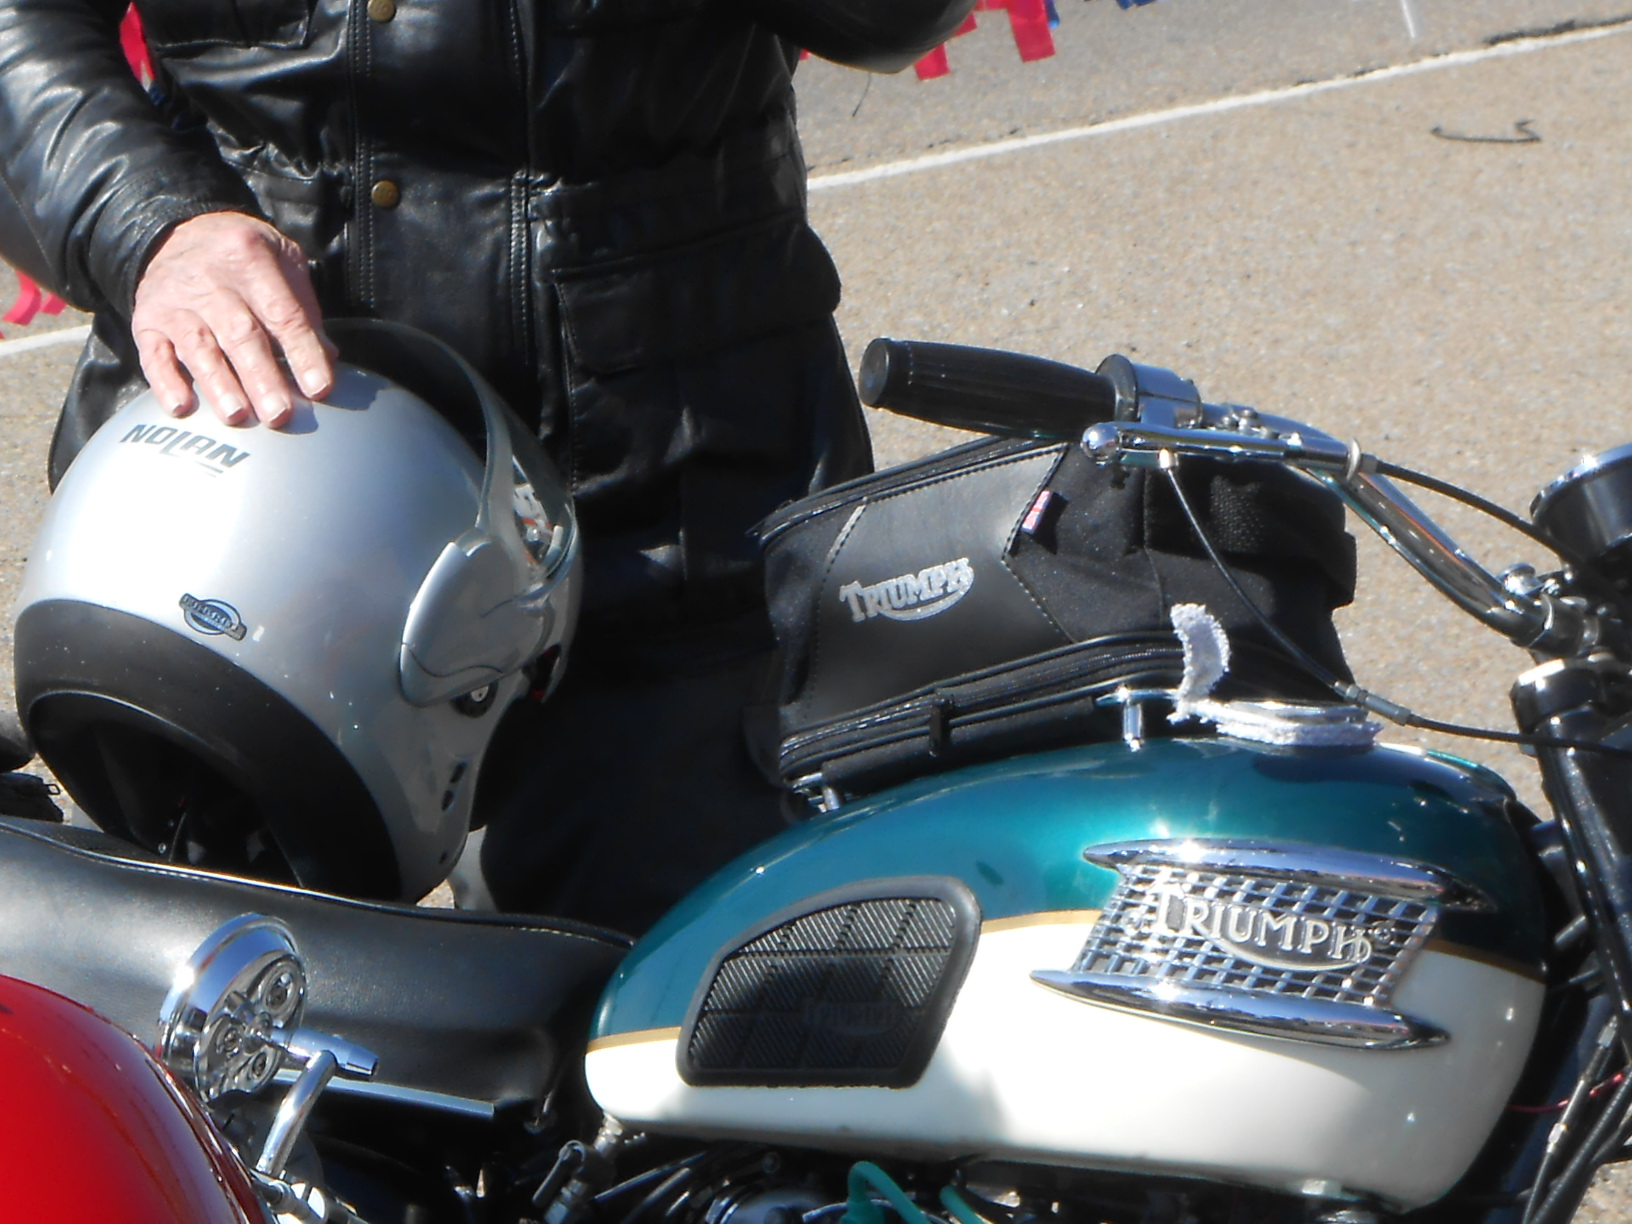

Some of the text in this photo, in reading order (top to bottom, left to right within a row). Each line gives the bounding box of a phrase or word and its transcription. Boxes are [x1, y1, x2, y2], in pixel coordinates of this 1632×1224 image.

[118, 423, 251, 469] NOLAN
[839, 557, 975, 623] TRIUMPH
[1142, 872, 1373, 971] TRIUMPH
